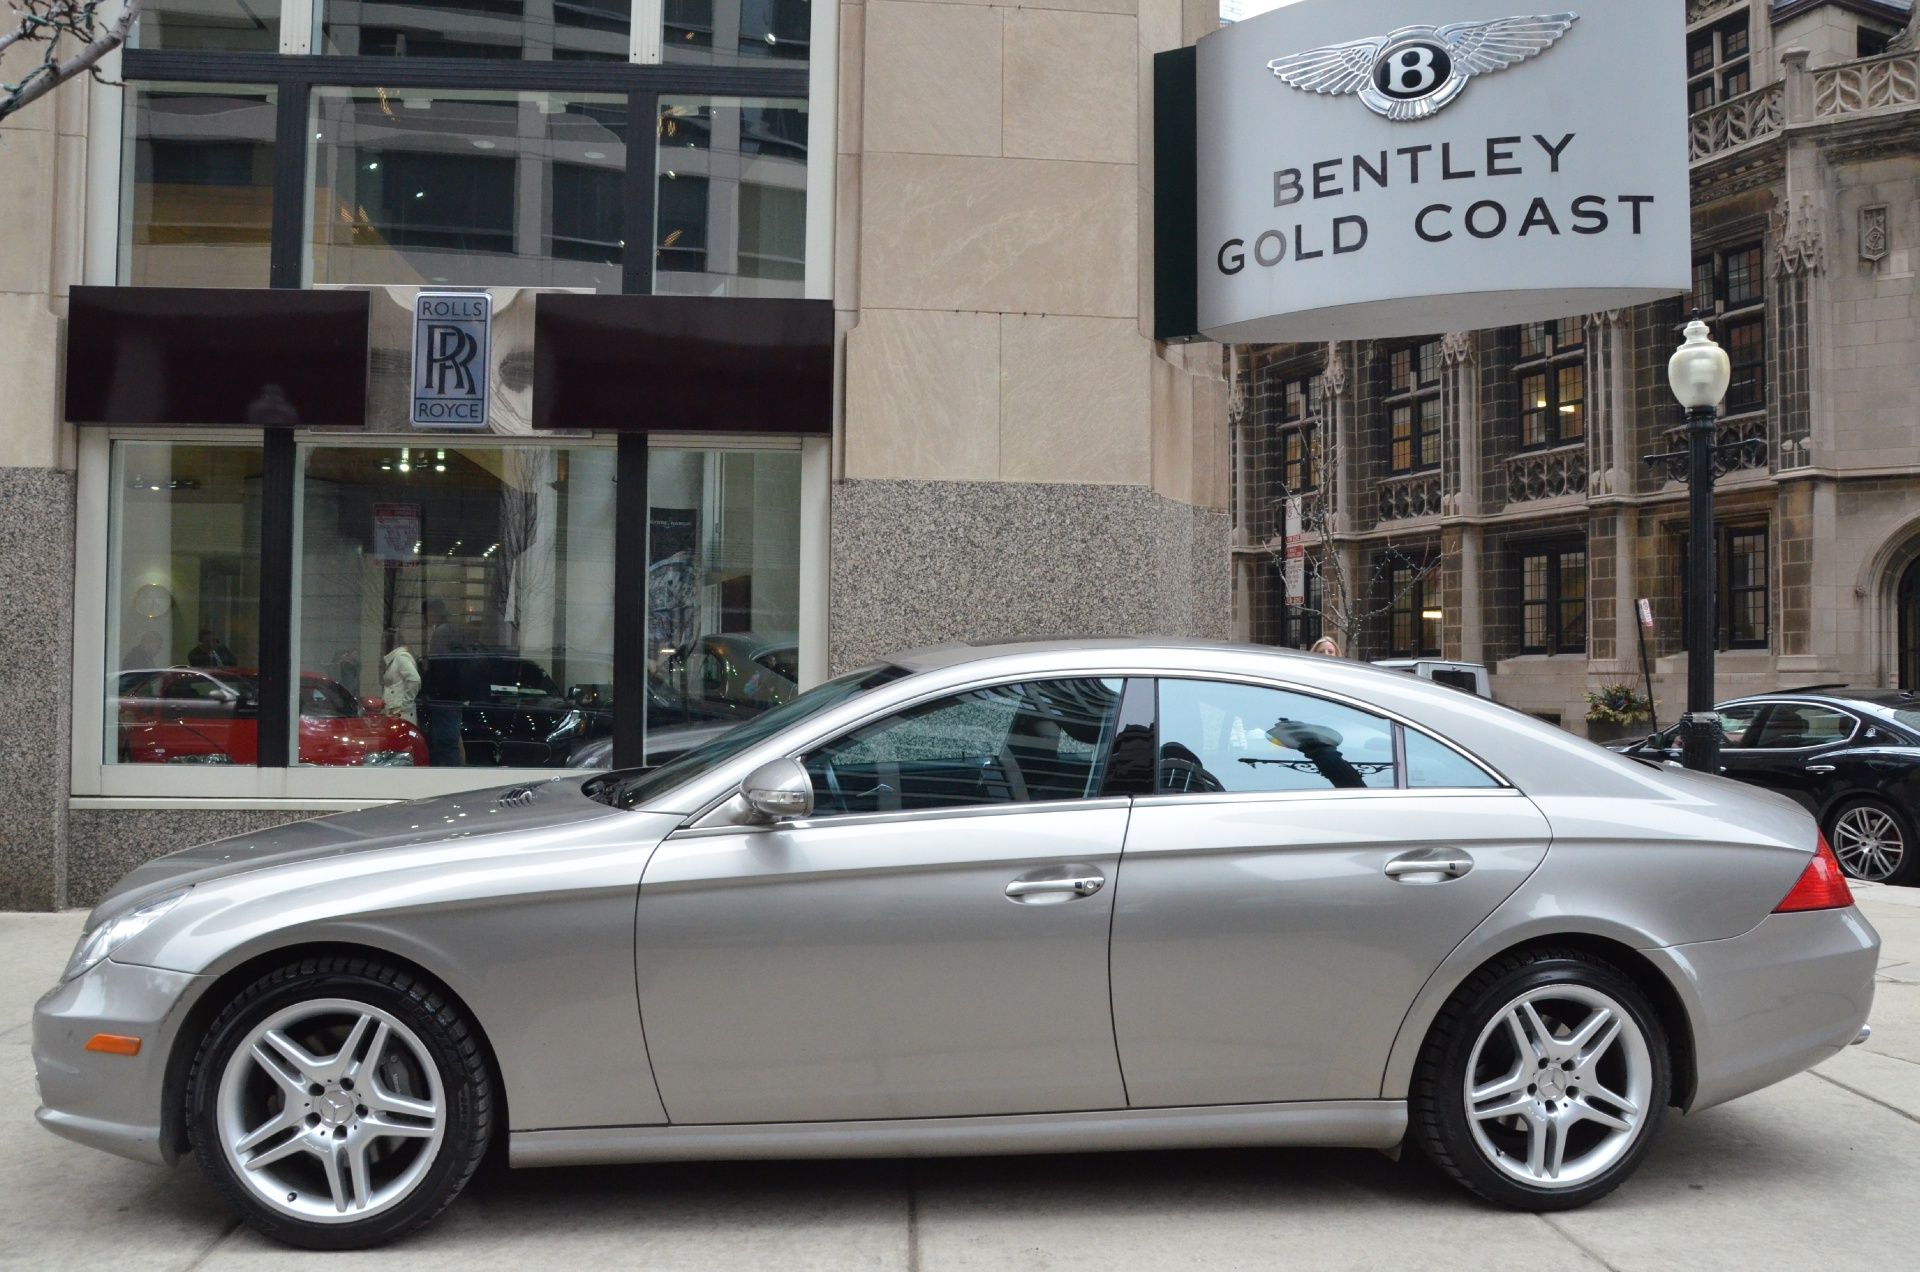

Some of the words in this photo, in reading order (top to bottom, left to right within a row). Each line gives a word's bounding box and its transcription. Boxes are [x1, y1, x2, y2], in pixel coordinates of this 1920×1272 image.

[1273, 132, 1576, 207] BENTLEY
[1217, 214, 1369, 276] GOLD
[1414, 194, 1655, 243] COAST
[422, 301, 482, 317] ROLLS
[418, 403, 479, 418] ROYCE
